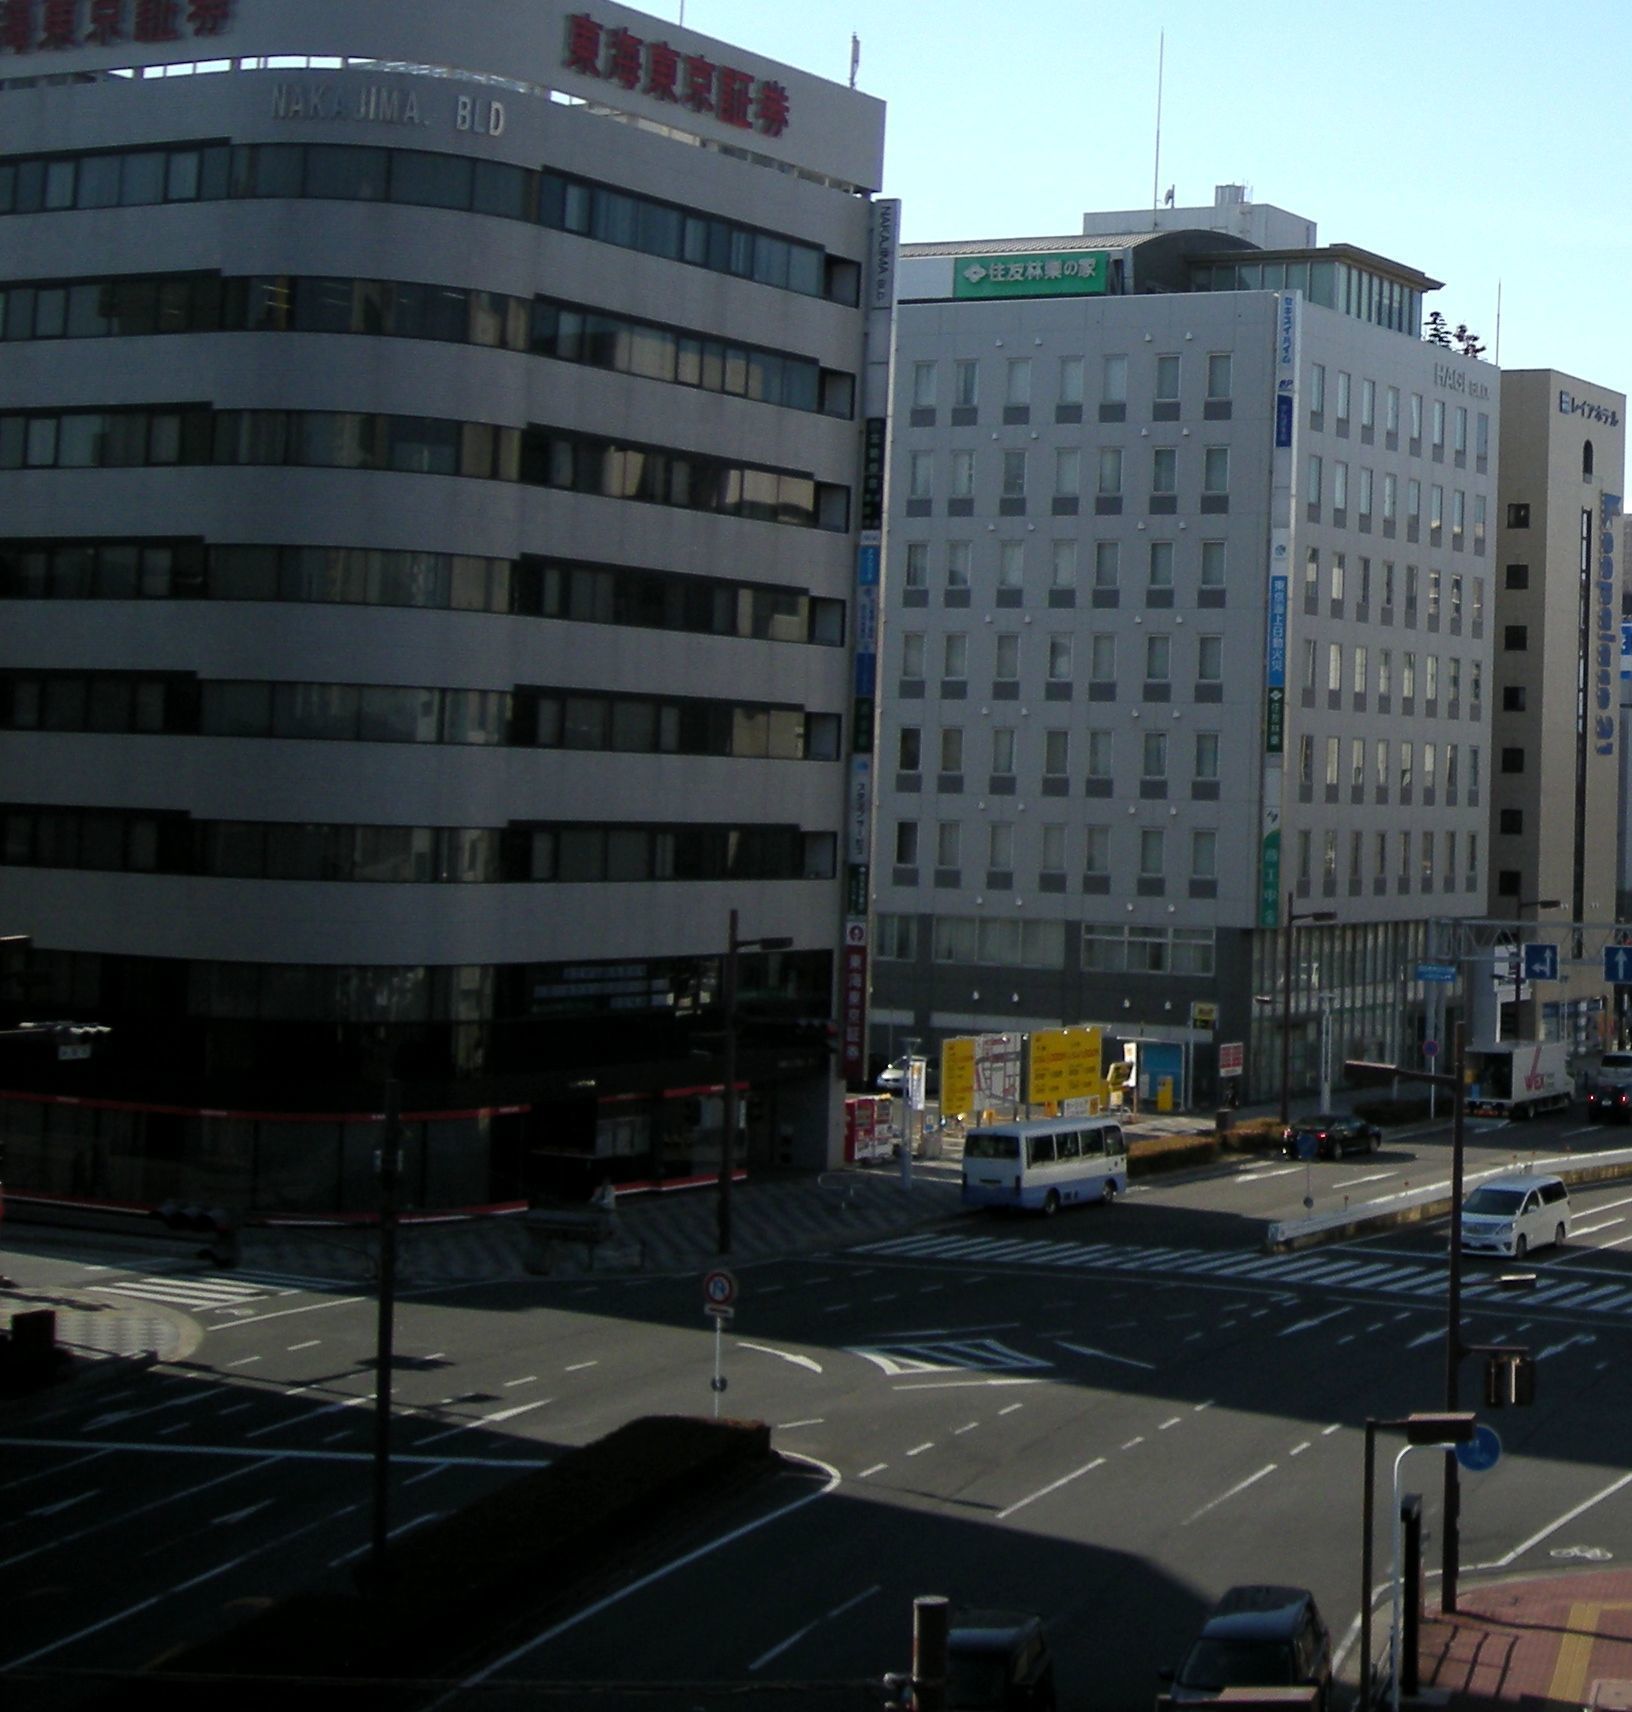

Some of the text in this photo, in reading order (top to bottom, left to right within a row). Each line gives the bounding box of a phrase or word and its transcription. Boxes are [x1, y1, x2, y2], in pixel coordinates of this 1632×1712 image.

[561, 13, 790, 137] 東海東京証券
[456, 95, 506, 137] BLD
[989, 258, 1096, 281] 住友林業の家
